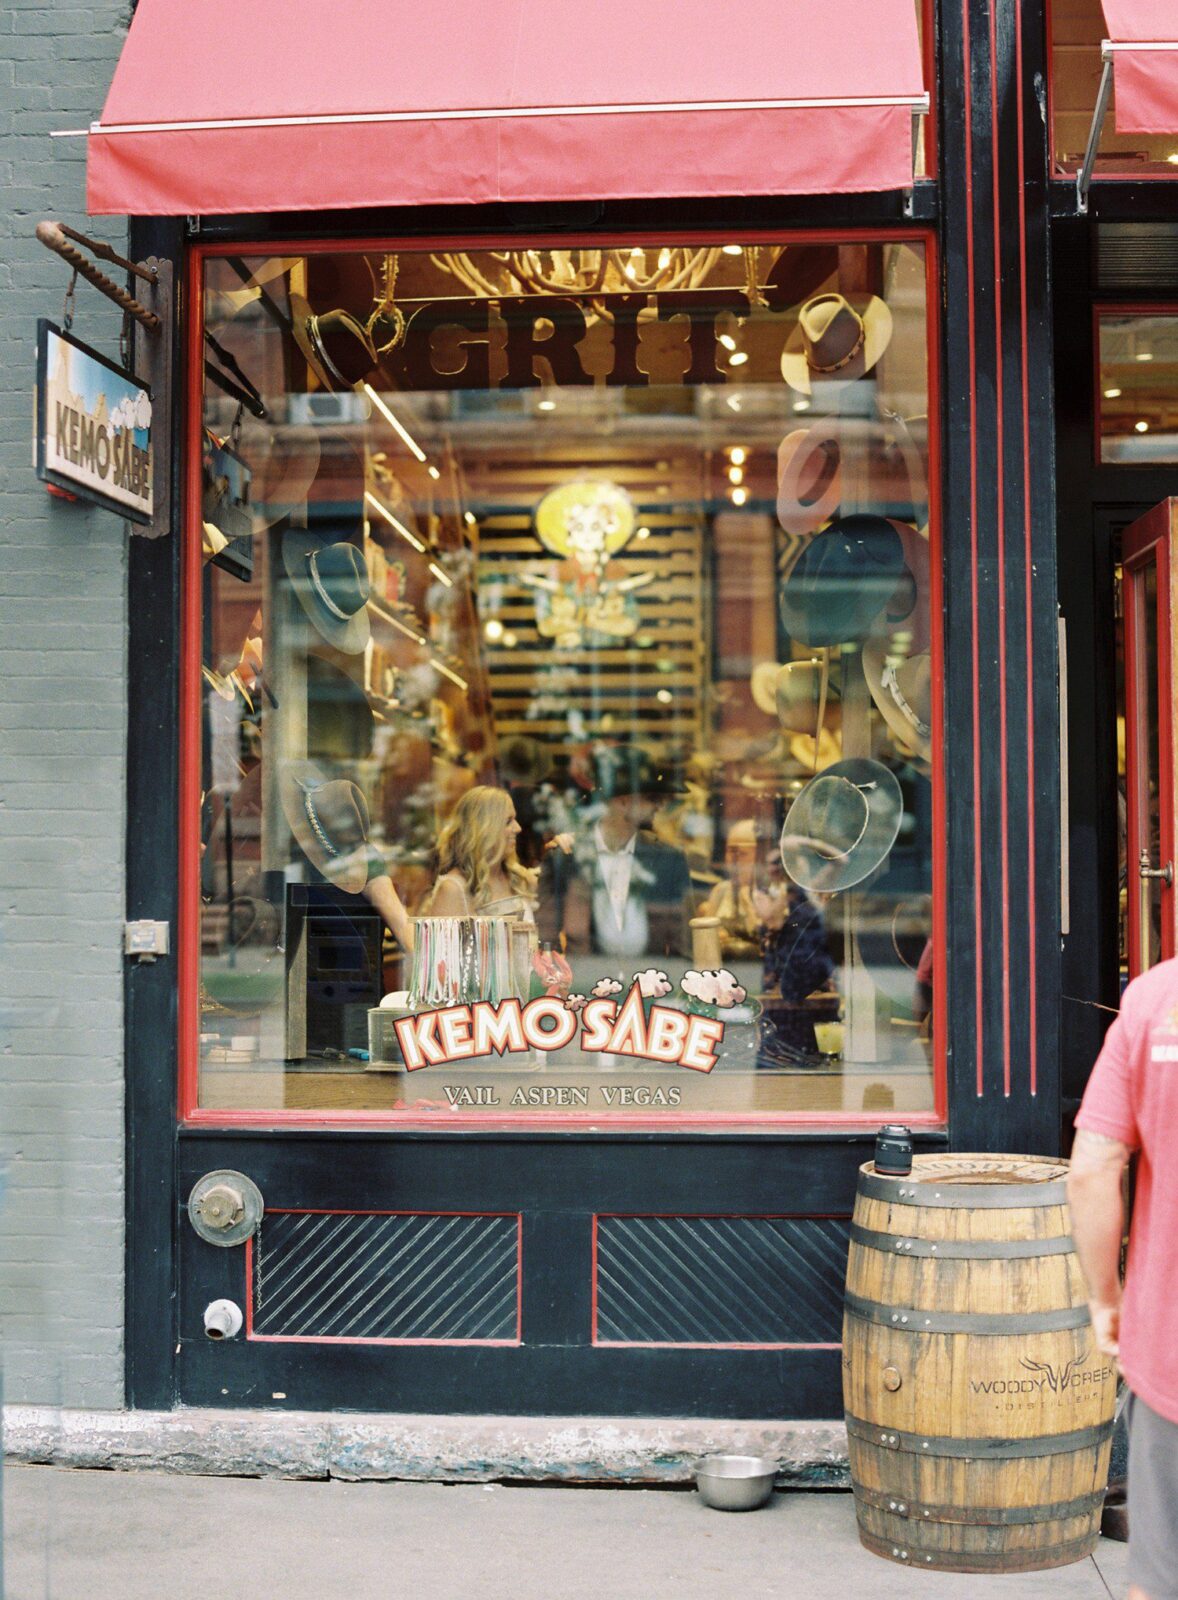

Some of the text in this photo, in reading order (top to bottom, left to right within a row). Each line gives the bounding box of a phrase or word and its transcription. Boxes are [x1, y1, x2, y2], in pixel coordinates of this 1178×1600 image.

[55, 400, 151, 500] KEMO SABE
[392, 974, 725, 1075] KEMO SABE
[444, 1086, 681, 1106] VAIL ASPEN VEGAS
[970, 1366, 1114, 1394] WOODY CREEK
